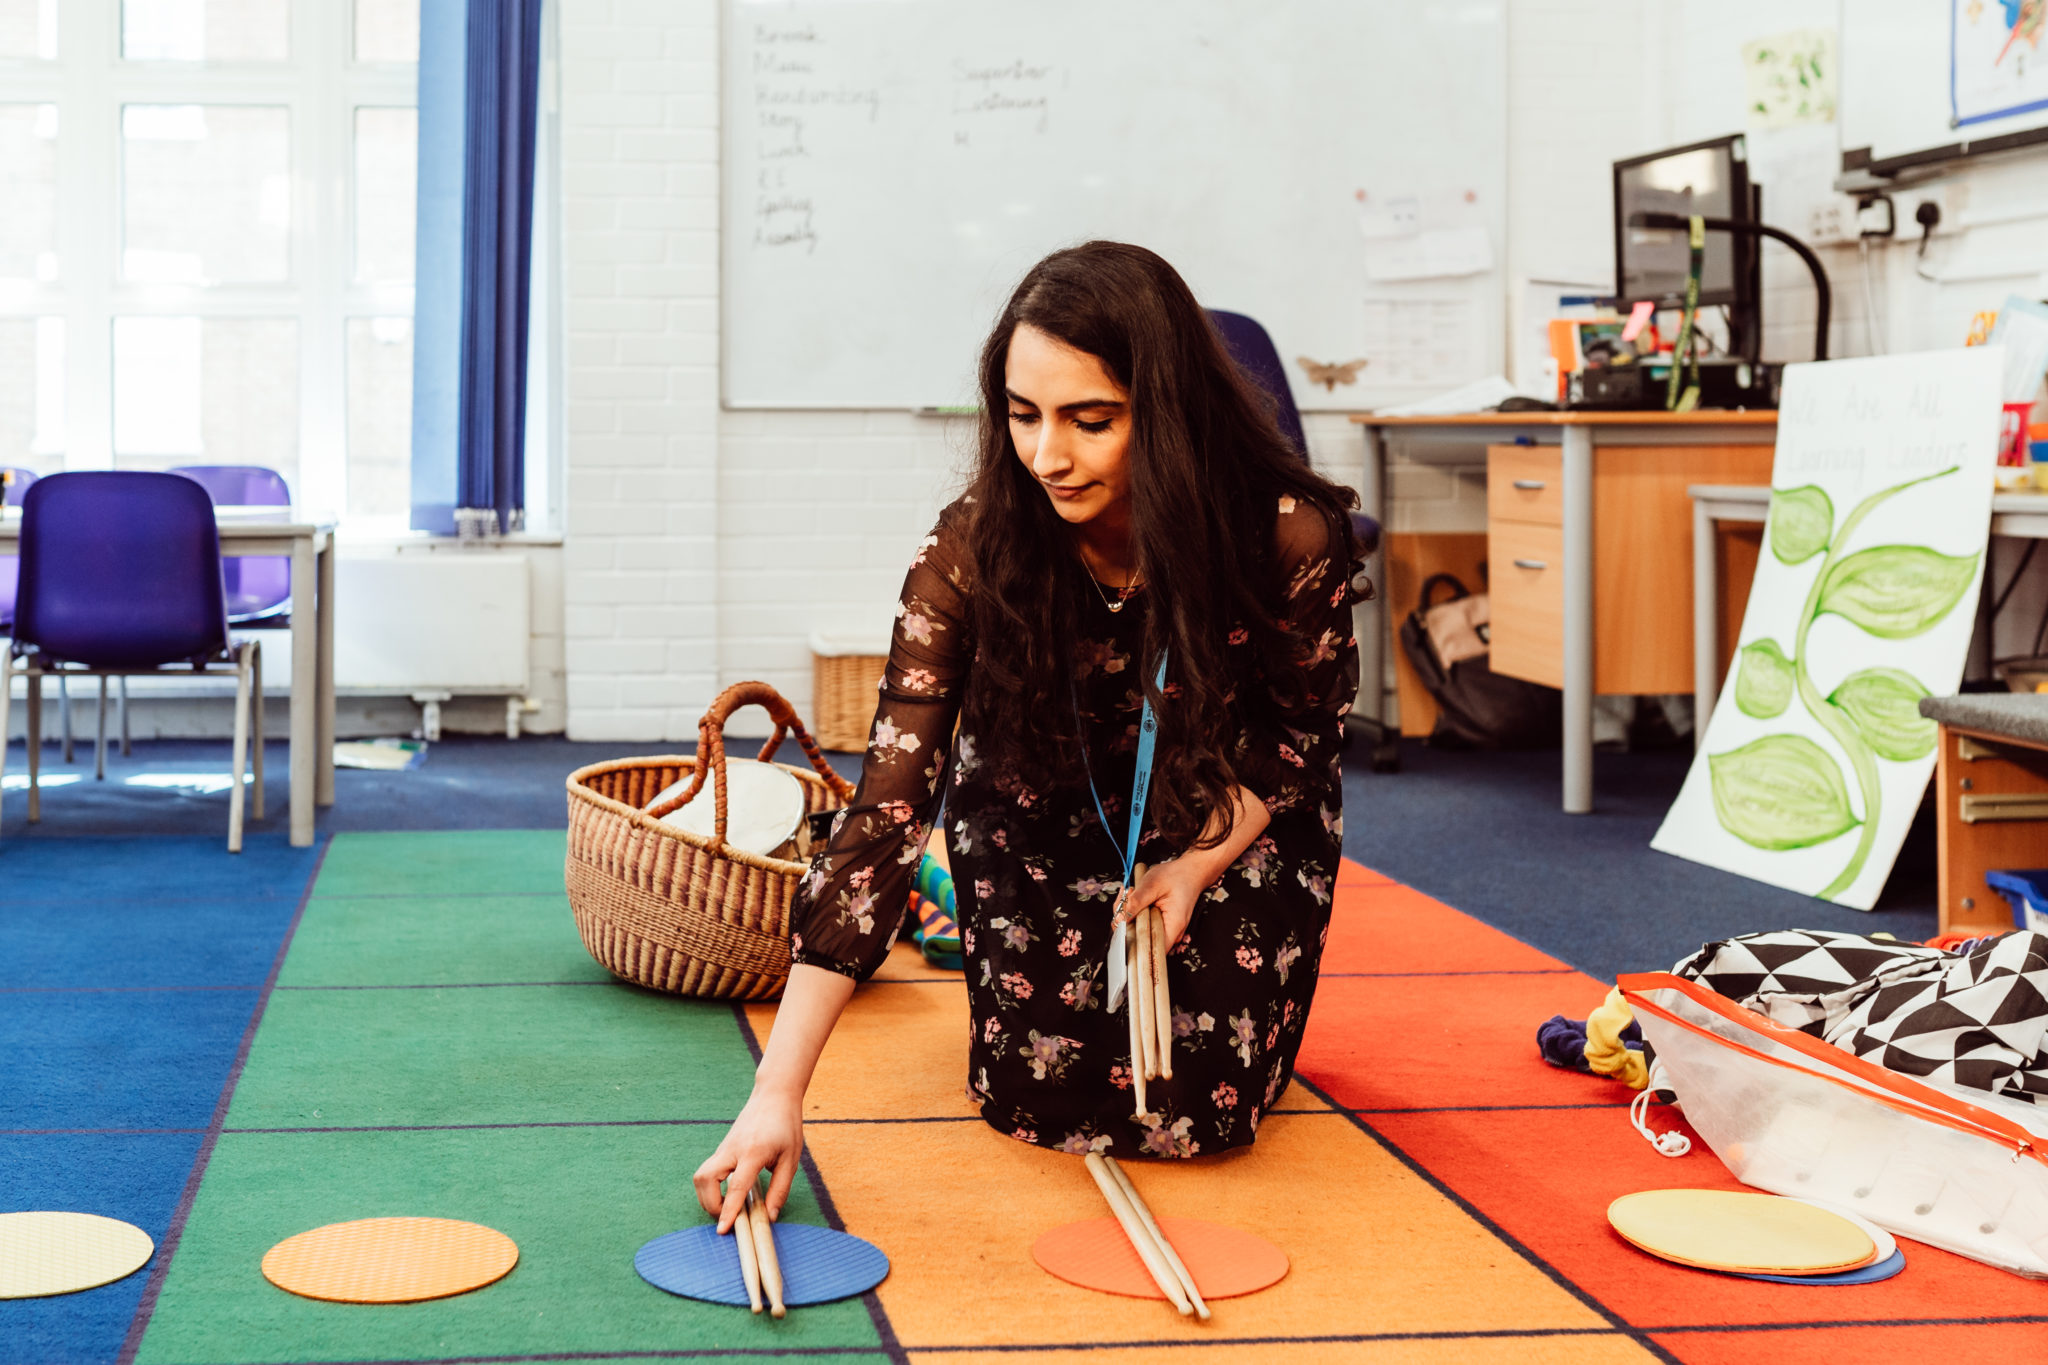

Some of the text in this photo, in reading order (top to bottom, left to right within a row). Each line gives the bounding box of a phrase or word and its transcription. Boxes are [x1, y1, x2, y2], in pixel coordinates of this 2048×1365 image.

[1842, 382, 1882, 422] Are
[1906, 382, 1943, 418] All
[1786, 427, 1968, 492] Learning Leaders
